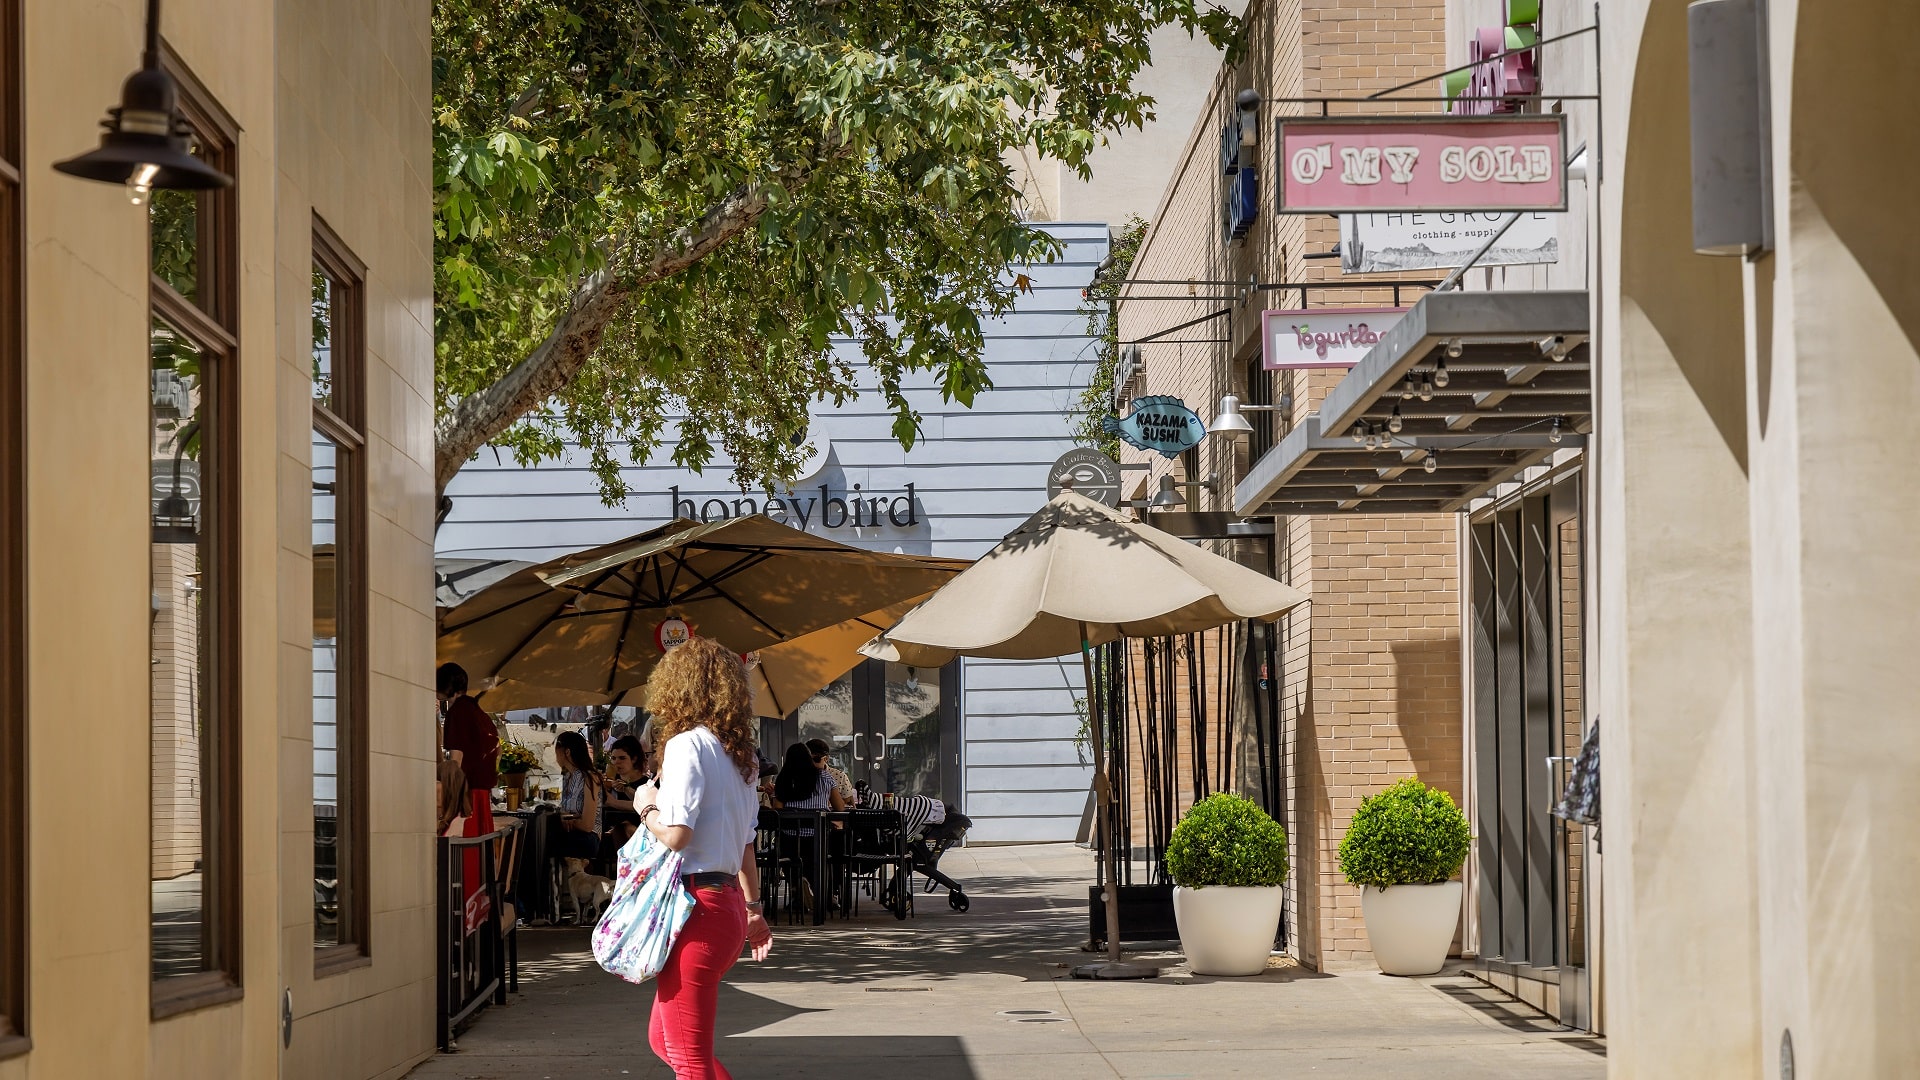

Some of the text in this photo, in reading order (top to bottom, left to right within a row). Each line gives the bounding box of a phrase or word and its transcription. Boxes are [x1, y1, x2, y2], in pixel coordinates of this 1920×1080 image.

[1340, 146, 1419, 186] MY
[1439, 145, 1552, 183] SOLE
[1370, 212, 1547, 228] THE GRO
[1412, 229, 1498, 240] clothing suppl
[1135, 412, 1188, 429] KAZAMA
[1142, 426, 1180, 444] SUSHI
[1063, 452, 1095, 467] Coffee
[1097, 456, 1116, 484] Bean
[668, 482, 920, 532] honeybird
